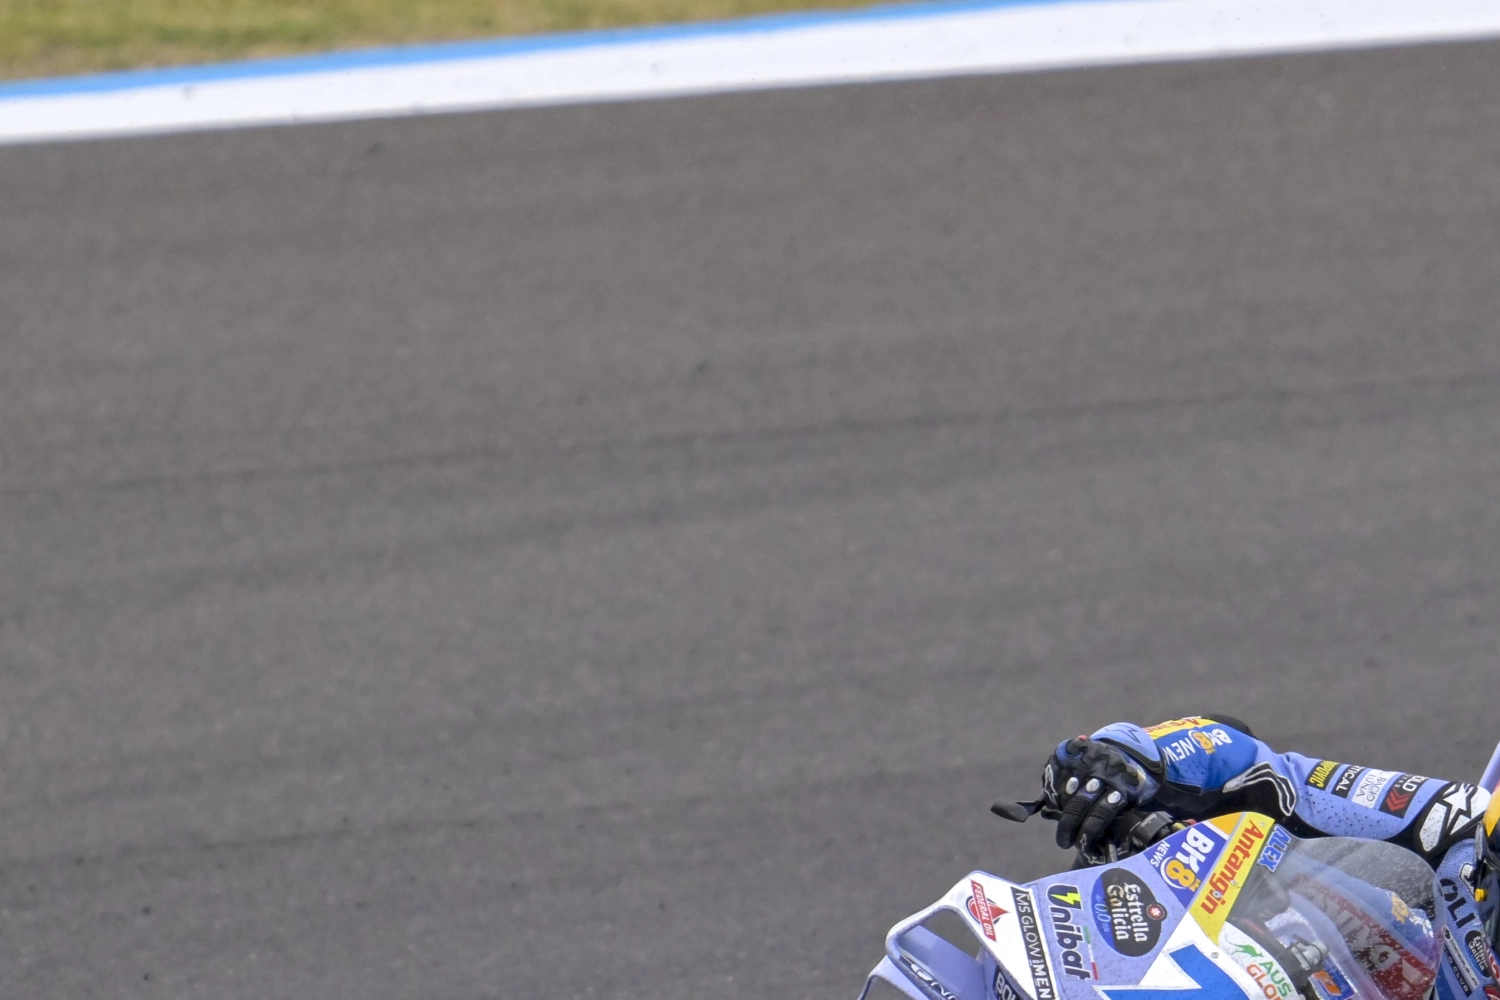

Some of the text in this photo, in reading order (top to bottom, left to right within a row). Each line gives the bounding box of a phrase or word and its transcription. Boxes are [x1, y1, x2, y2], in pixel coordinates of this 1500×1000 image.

[1150, 840, 1171, 867] NEWS
[1163, 828, 1215, 892] BK8
[1200, 820, 1265, 914] Antangin
[1257, 825, 1291, 872] ALEX
[974, 883, 995, 937] FEDERAL OIL
[1014, 892, 1031, 912] MS
[1107, 884, 1130, 940] Galicia
[1124, 882, 1149, 942] Estrella
[1020, 913, 1043, 961] GLOW
[1048, 884, 1093, 981] Unibat
[1260, 961, 1292, 997] AUS
